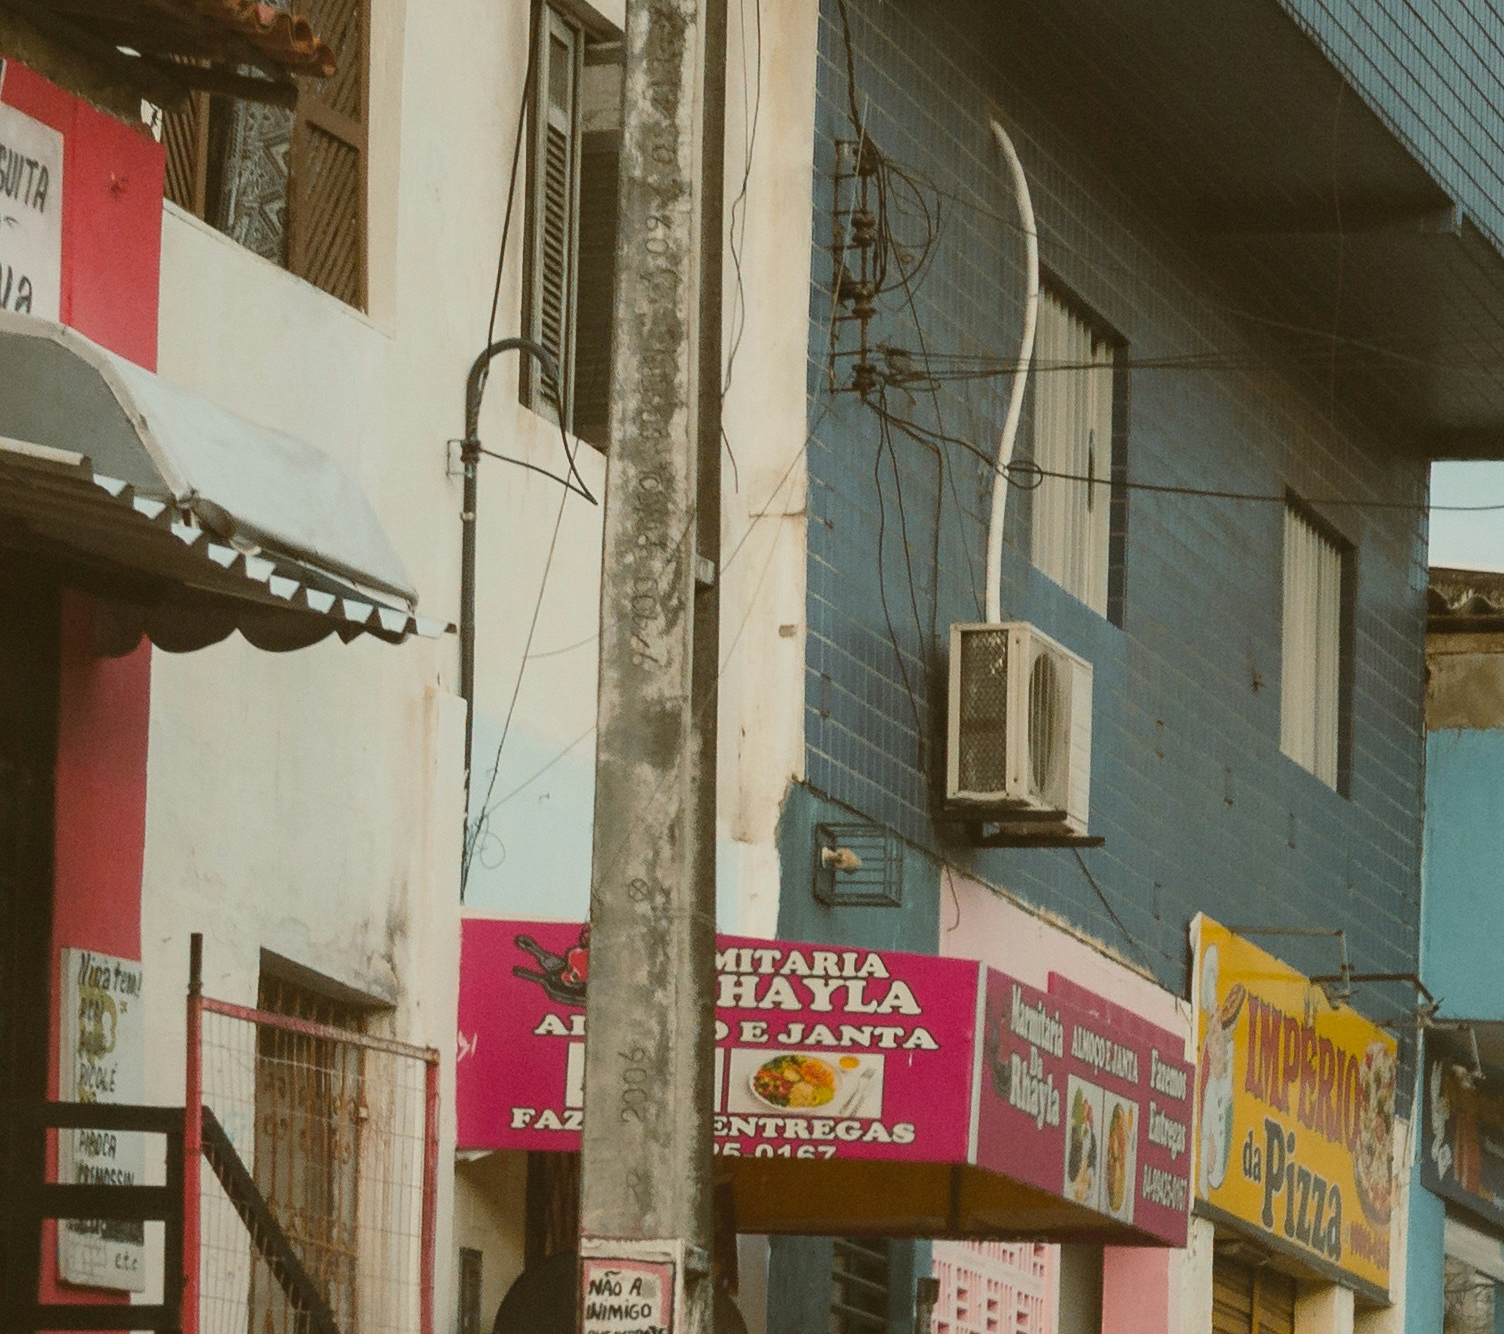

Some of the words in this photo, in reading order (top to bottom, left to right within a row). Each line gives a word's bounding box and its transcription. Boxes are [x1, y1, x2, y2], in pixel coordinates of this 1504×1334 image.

[739, 1020, 770, 1043] E
[777, 1023, 939, 1050] JANTA
[1242, 1131, 1262, 1183] da
[1261, 1117, 1342, 1263] Pizza
[588, 1270, 623, 1297] NÃO
[586, 1300, 652, 1321] INIMIGO
